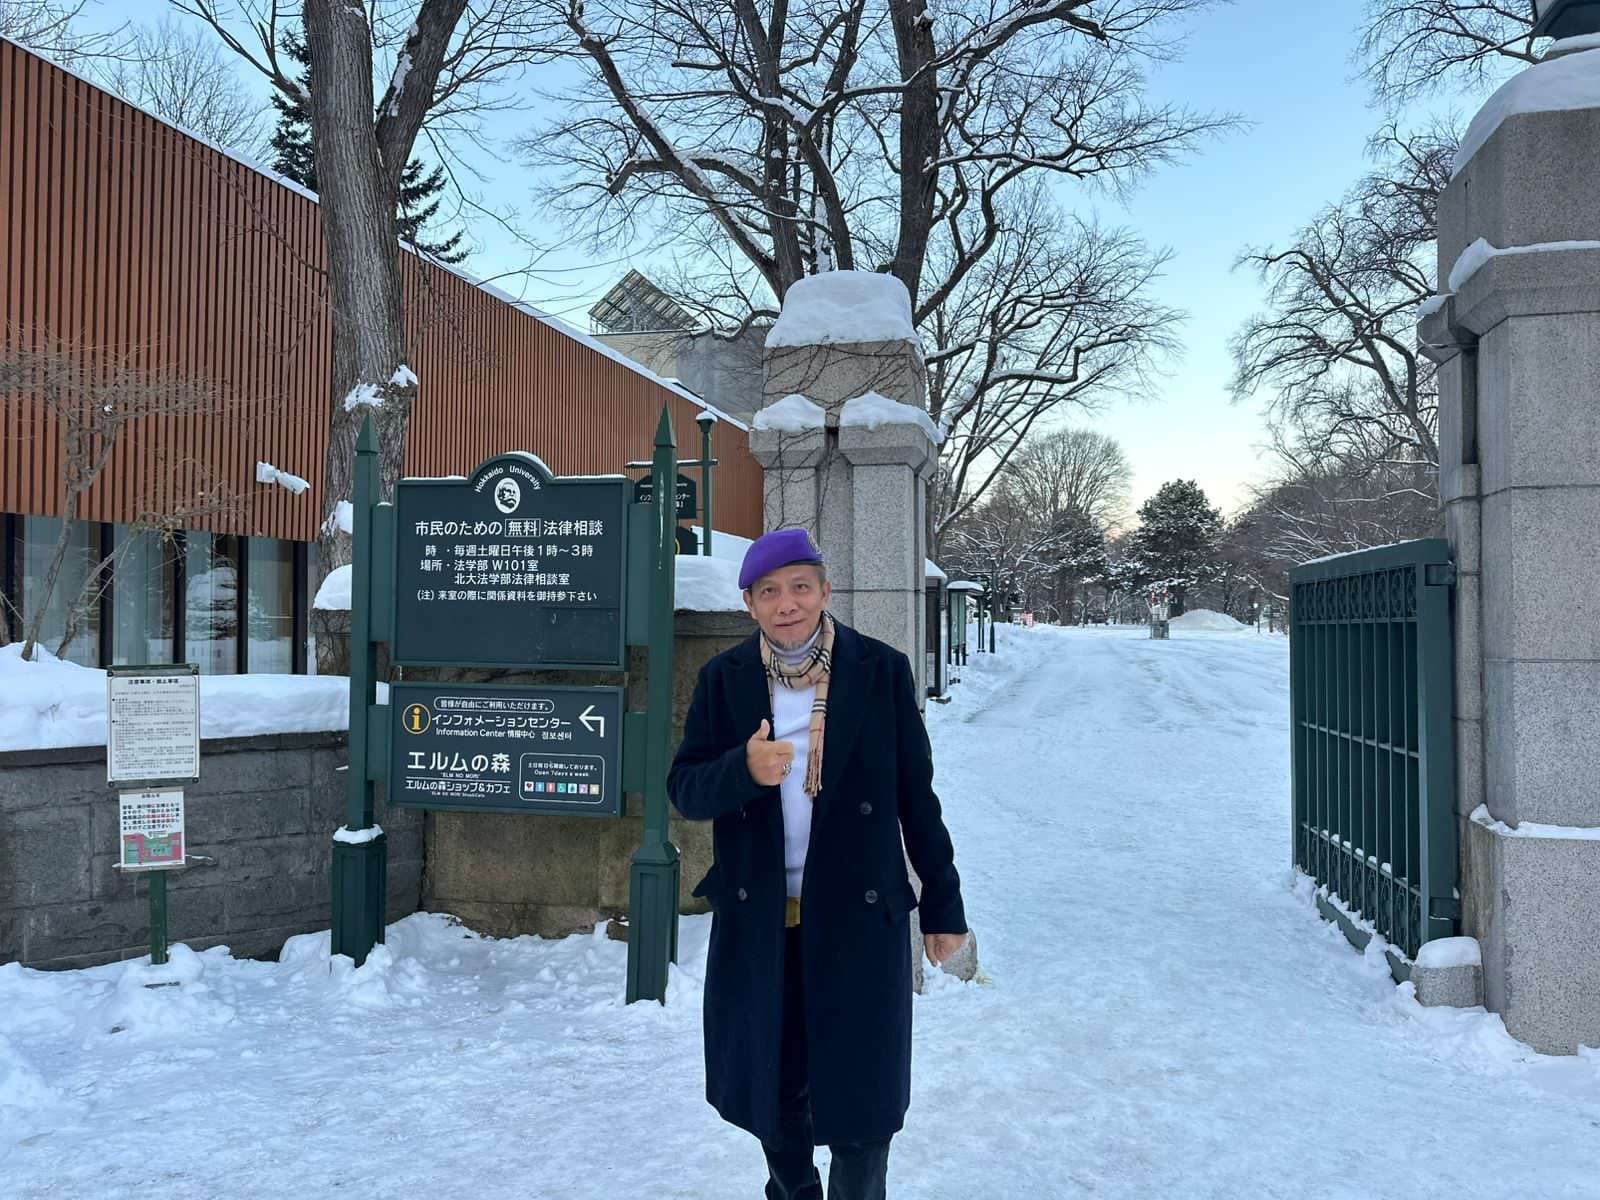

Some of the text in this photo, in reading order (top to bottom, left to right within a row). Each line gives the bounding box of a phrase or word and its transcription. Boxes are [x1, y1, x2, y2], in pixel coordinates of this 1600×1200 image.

[474, 465, 541, 493] Hokkaido University
[415, 520, 603, 537] 市民のための 無料 法律相談
[492, 559, 539, 572] W101室
[454, 573, 570, 586] 北大法学部法律相談室
[432, 714, 571, 729] インフォメーションセンター
[436, 727, 479, 737] Information
[480, 729, 505, 738] Center
[407, 751, 511, 774] エルムの森
[405, 780, 511, 794] エルムの森ショップ&カフェ
